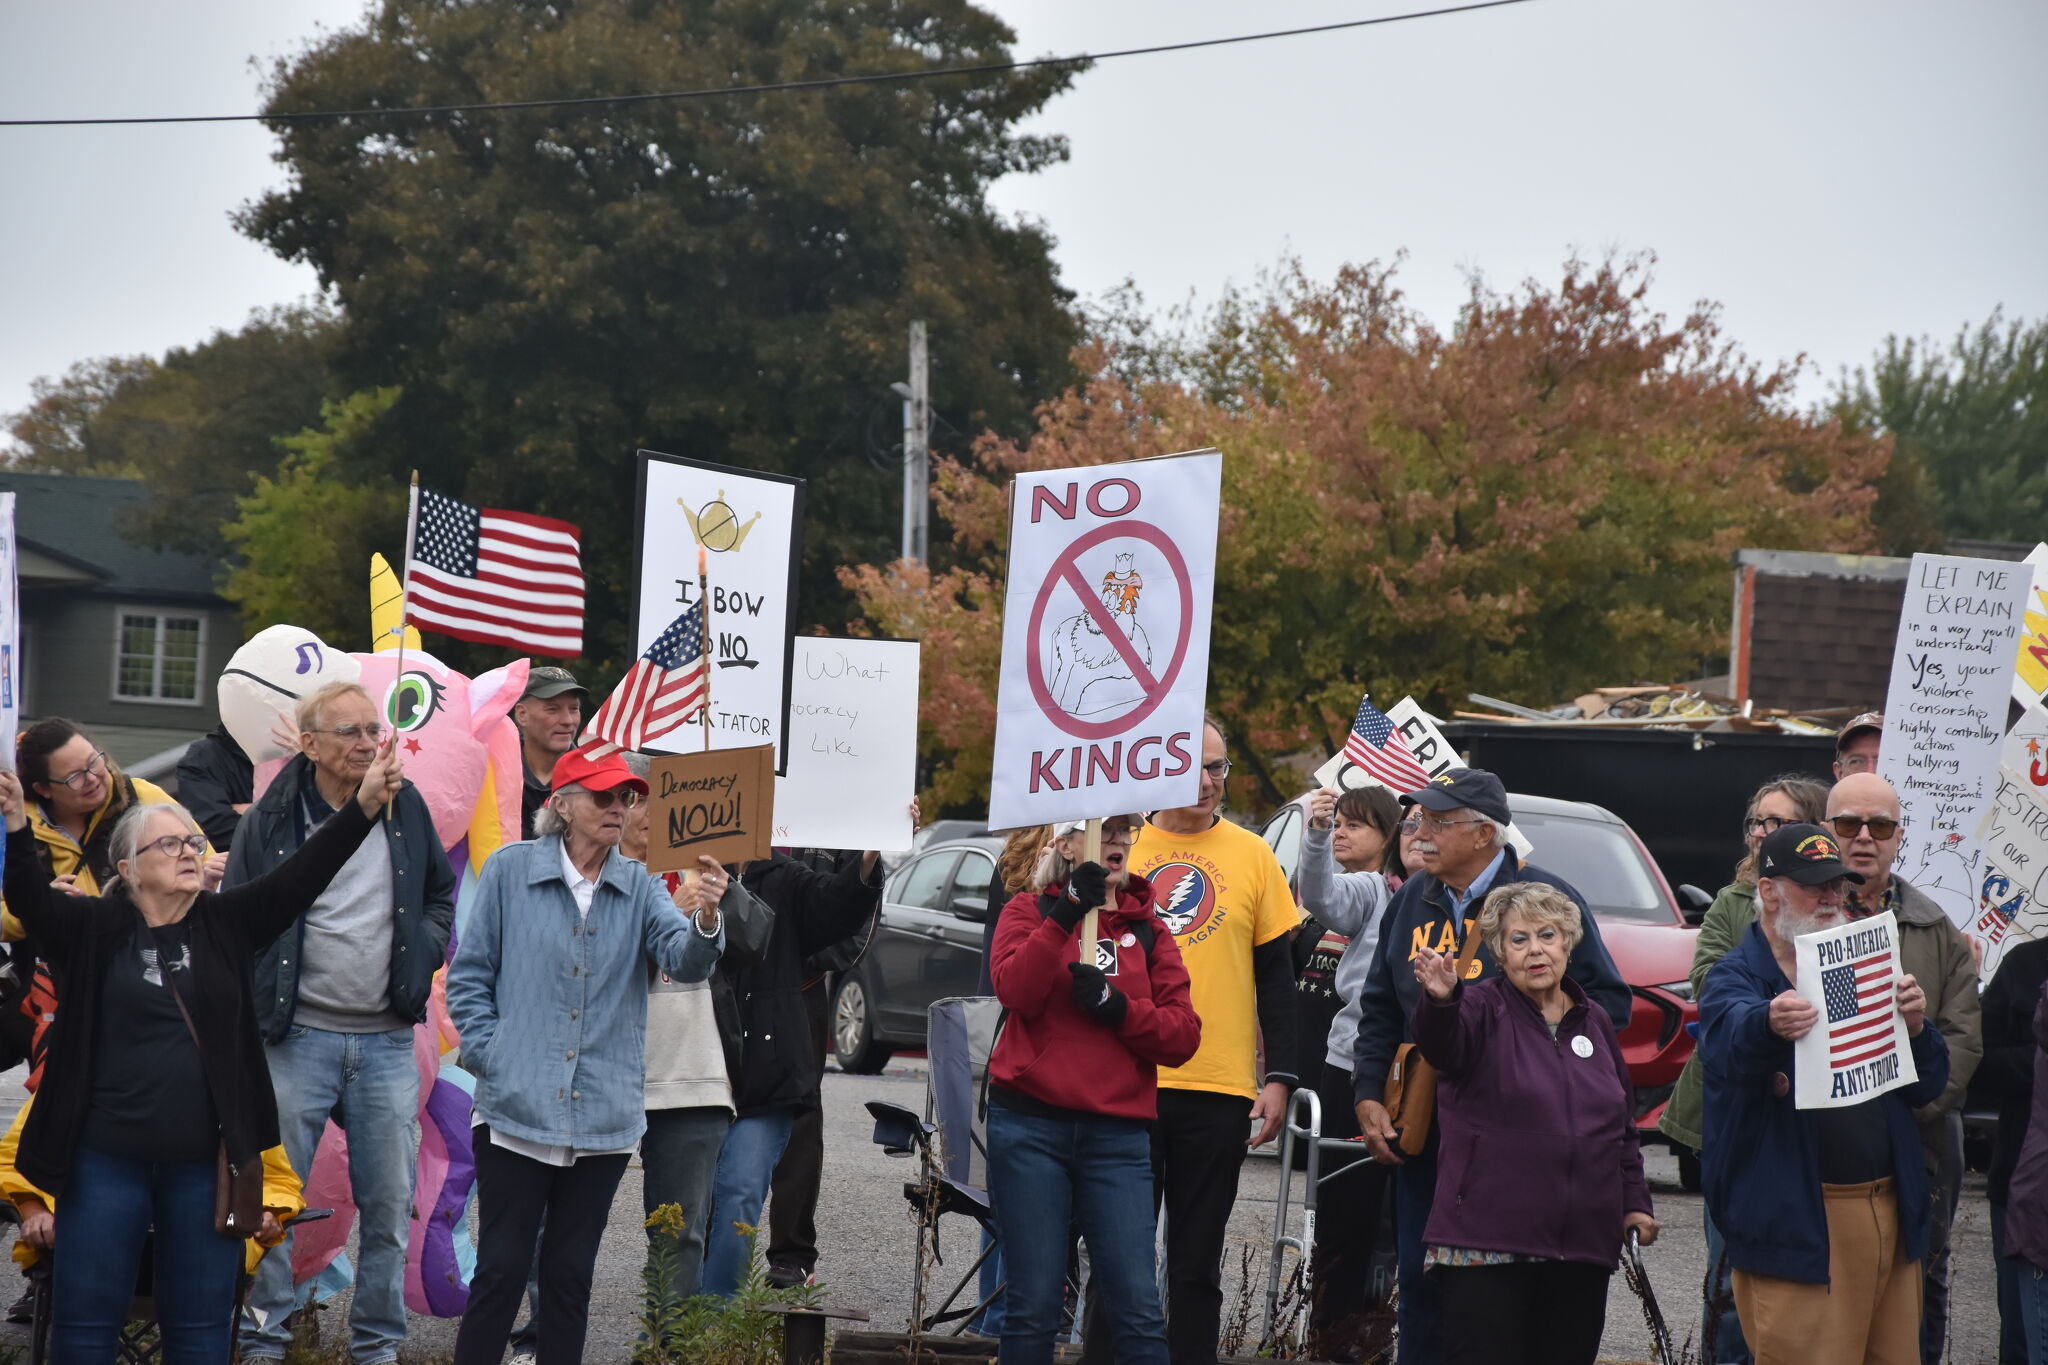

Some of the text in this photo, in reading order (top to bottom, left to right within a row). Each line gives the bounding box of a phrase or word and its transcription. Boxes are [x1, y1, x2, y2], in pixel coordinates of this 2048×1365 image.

[1030, 478, 1142, 523] NO
[1921, 562, 2009, 591] LET ME
[675, 579, 764, 617] I BOW
[1926, 594, 2013, 620] EXPLAIN
[1908, 619, 2016, 644] in a way you'll
[719, 632, 748, 661] NO
[806, 651, 890, 682] What
[1958, 664, 2001, 687] your
[718, 712, 771, 736] TATOR
[1909, 702, 1989, 725] censorship
[1900, 719, 1936, 741] highly
[811, 732, 860, 757] Like
[1913, 738, 1955, 751] actions
[1029, 732, 1192, 793] KINGS
[1907, 753, 1960, 775] bullying
[1903, 775, 1967, 793] Americans
[668, 791, 742, 846] NOW!
[1931, 815, 1960, 831] look
[1935, 803, 1976, 821] your
[2003, 842, 2030, 871] OUR
[1137, 851, 1228, 894] AKE AMERICA
[1187, 905, 1228, 947] AGAIN!
